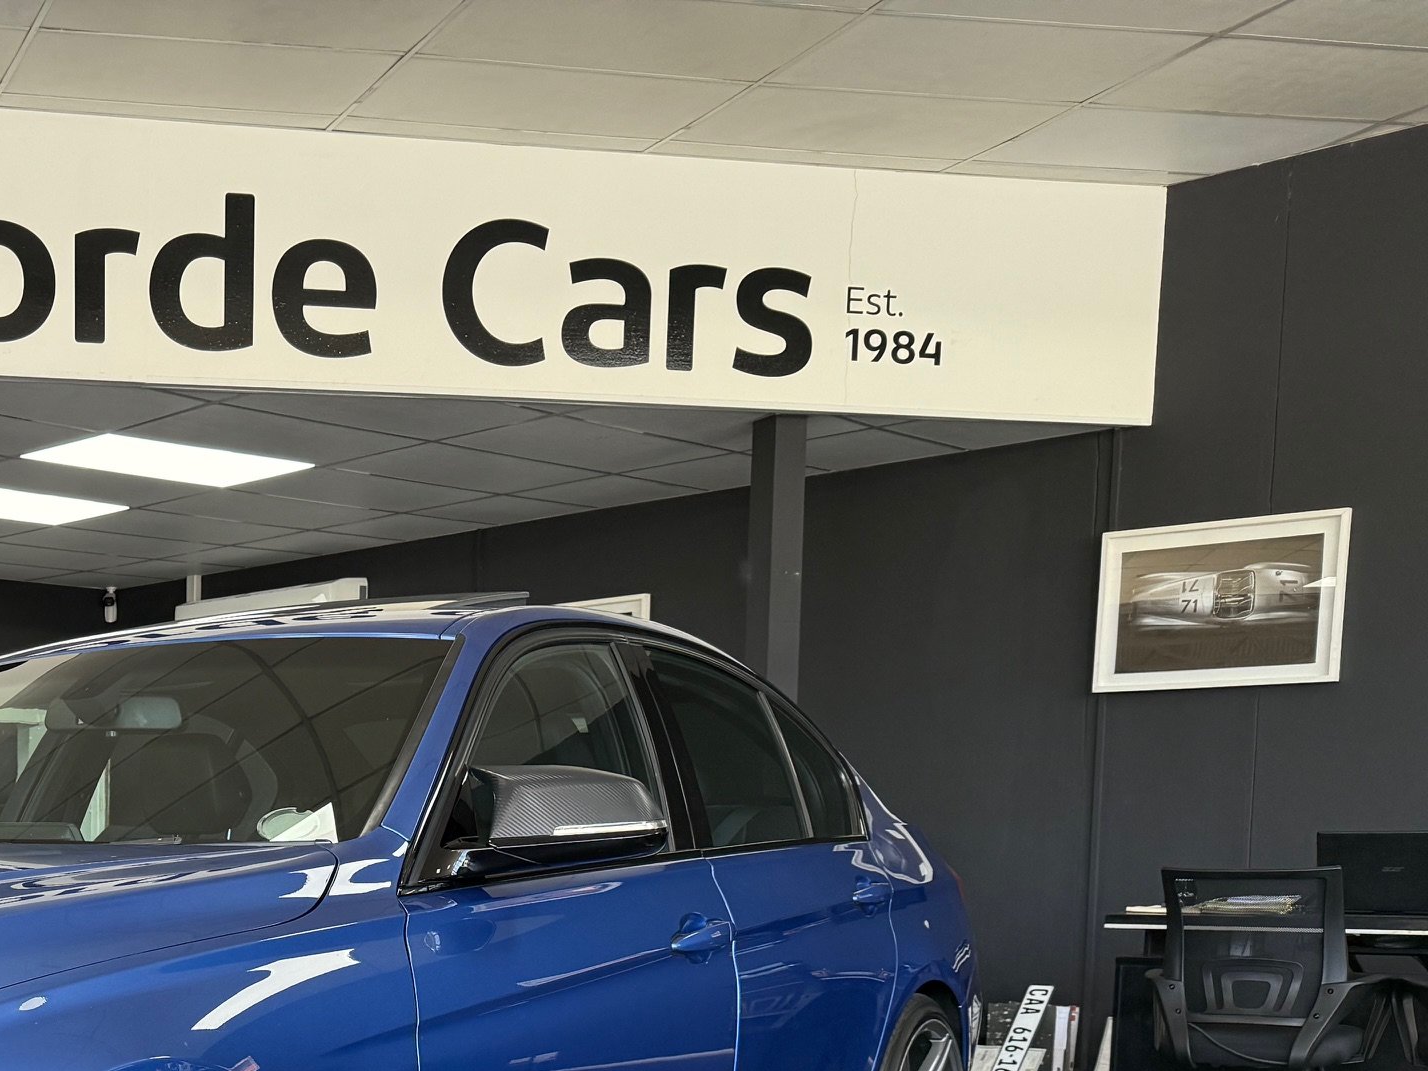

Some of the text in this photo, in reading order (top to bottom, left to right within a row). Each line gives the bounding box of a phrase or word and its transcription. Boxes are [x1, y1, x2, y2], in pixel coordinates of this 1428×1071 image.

[442, 218, 813, 378] Cars
[846, 286, 904, 317] Est.
[845, 328, 942, 366] 1984
[1180, 599, 1199, 614] 71
[1020, 988, 1049, 1015] CAA
